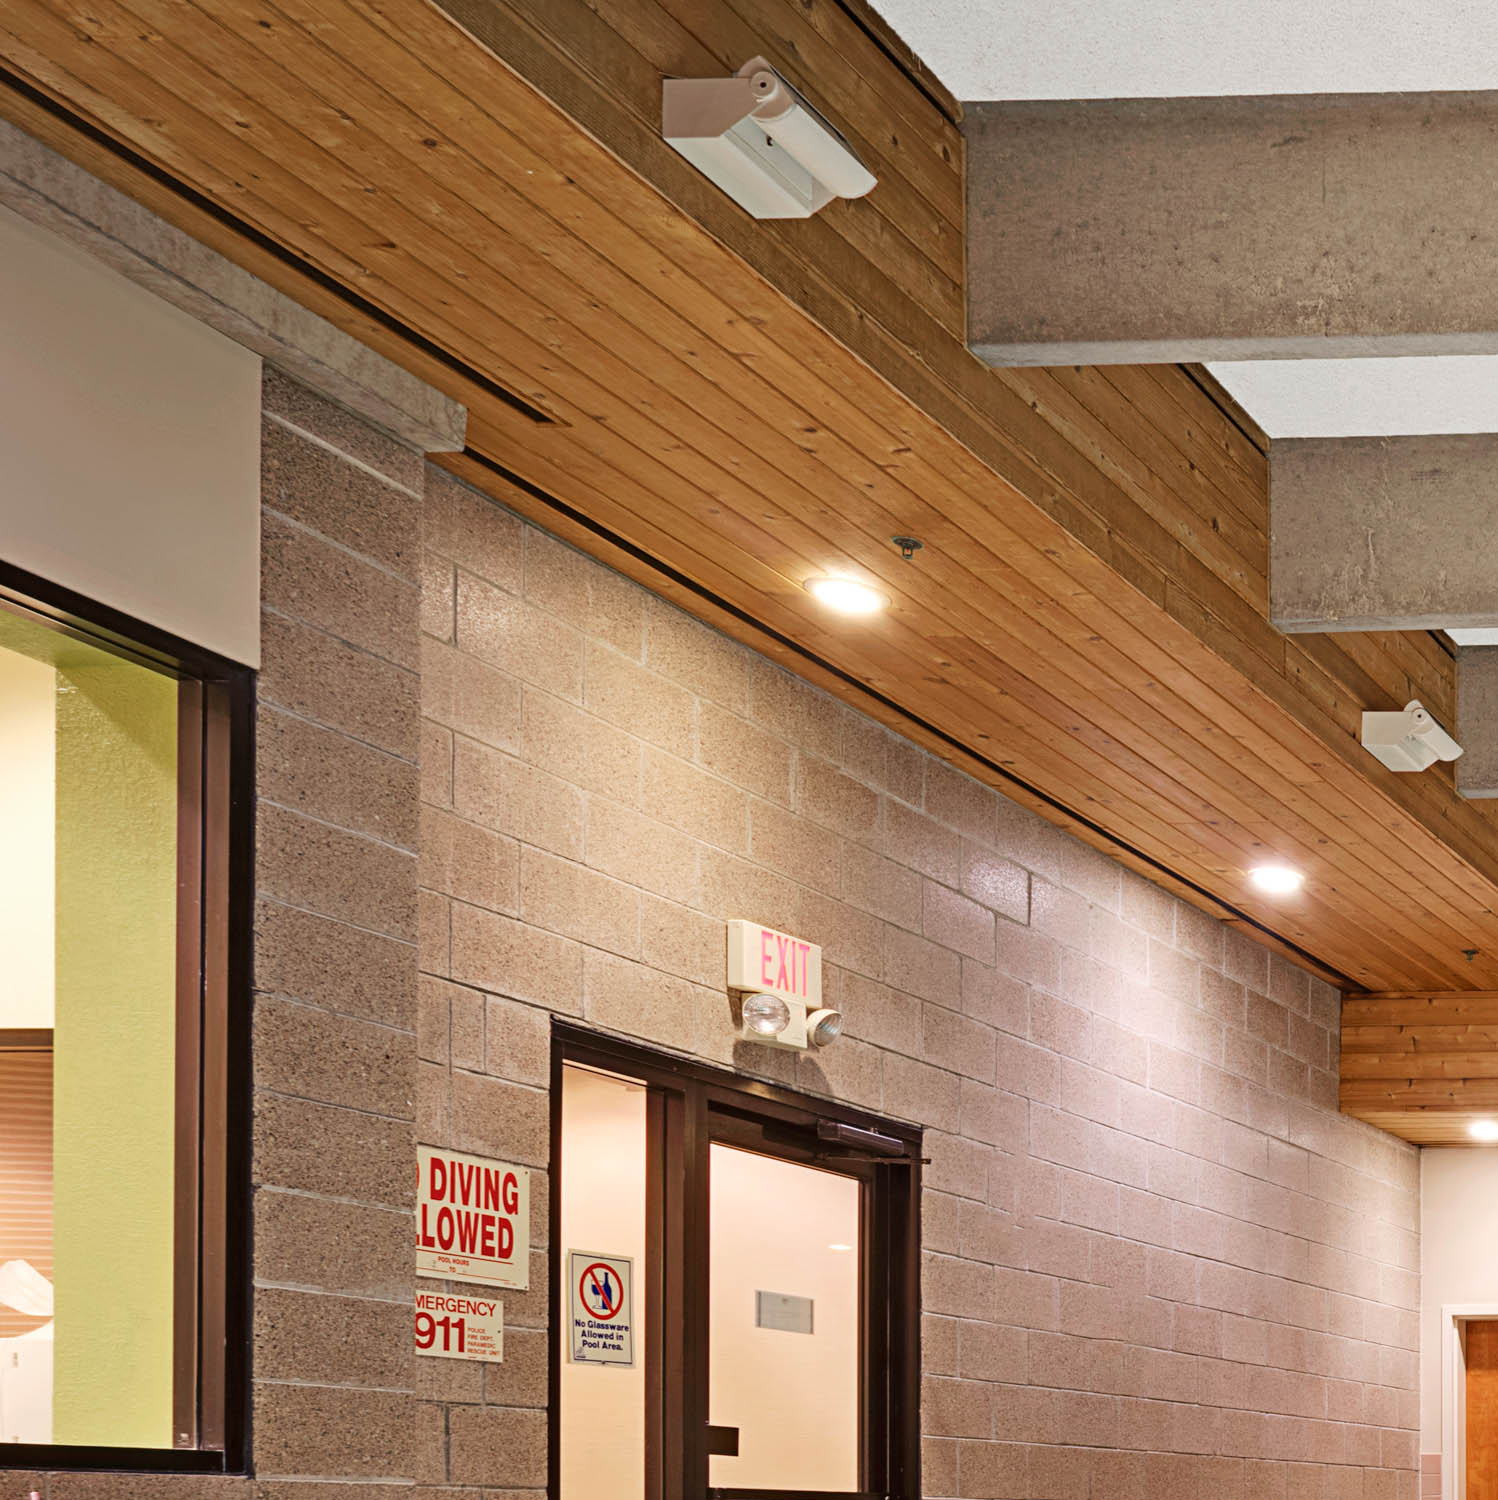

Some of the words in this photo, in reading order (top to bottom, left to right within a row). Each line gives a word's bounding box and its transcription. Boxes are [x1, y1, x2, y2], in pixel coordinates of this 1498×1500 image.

[761, 930, 810, 997] EXIT
[430, 1156, 518, 1216] DIVING
[416, 1203, 514, 1260] LOWED
[416, 1312, 465, 1352] 911
[575, 1319, 585, 1327] No
[587, 1320, 629, 1331] Glassware
[581, 1330, 614, 1340] Allowed
[616, 1333, 624, 1341] in
[582, 1339, 599, 1348] Pool
[602, 1341, 623, 1351] Area.
